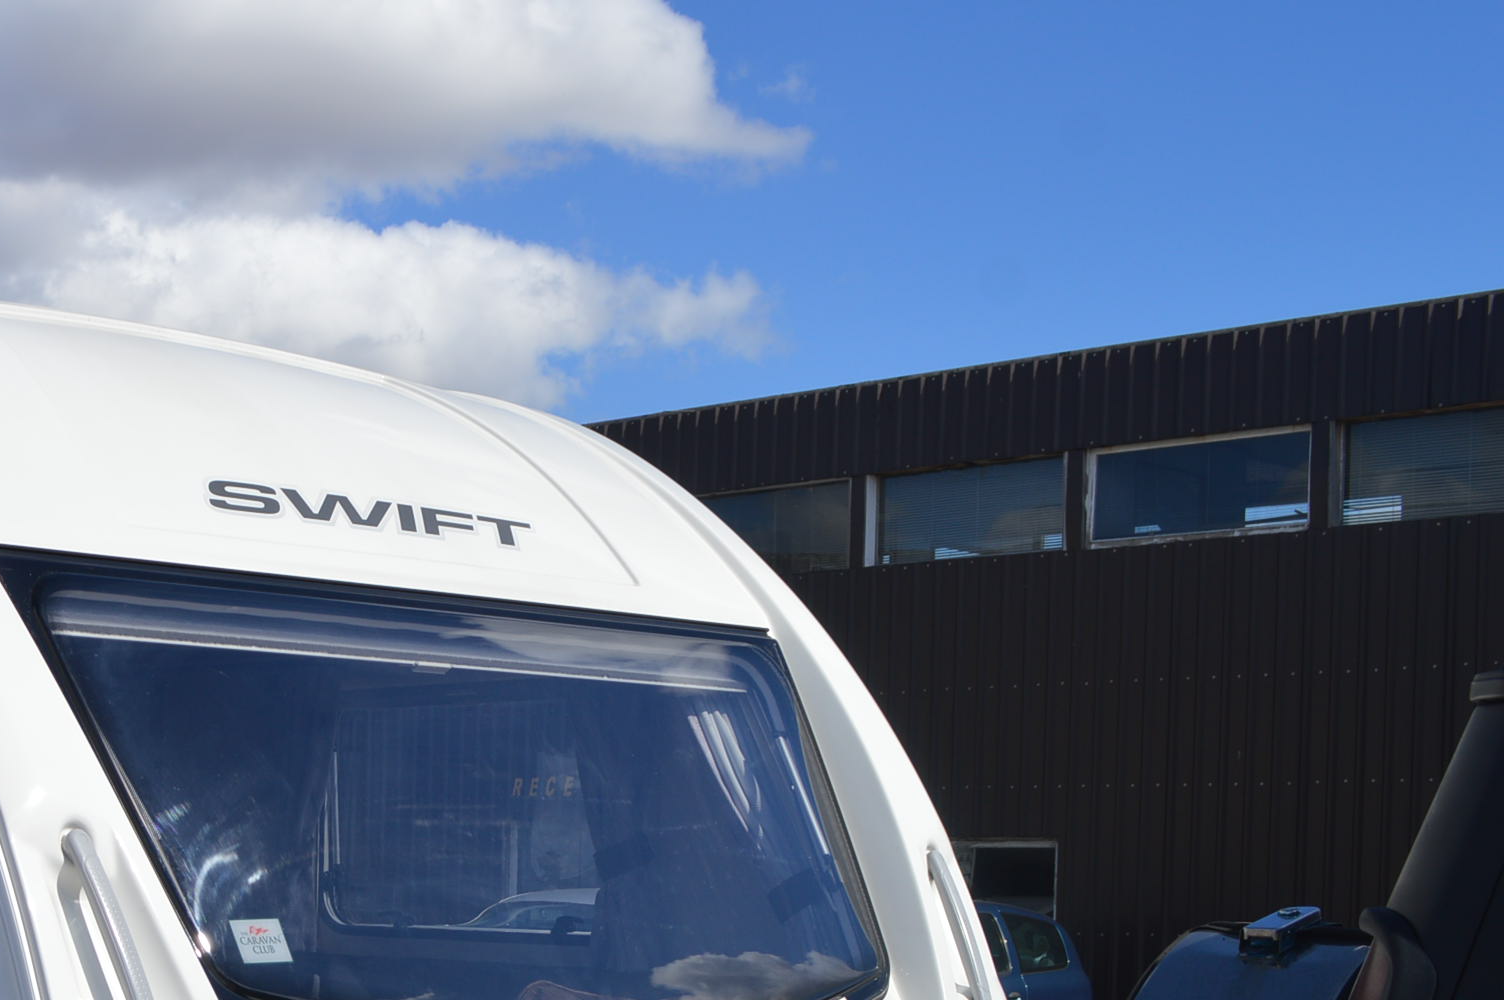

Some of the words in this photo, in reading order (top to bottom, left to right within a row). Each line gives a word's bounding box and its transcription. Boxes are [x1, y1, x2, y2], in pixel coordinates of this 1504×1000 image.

[209, 480, 532, 546] SWIFT
[240, 936, 281, 945] CARAVAN
[253, 945, 275, 954] CLUB
